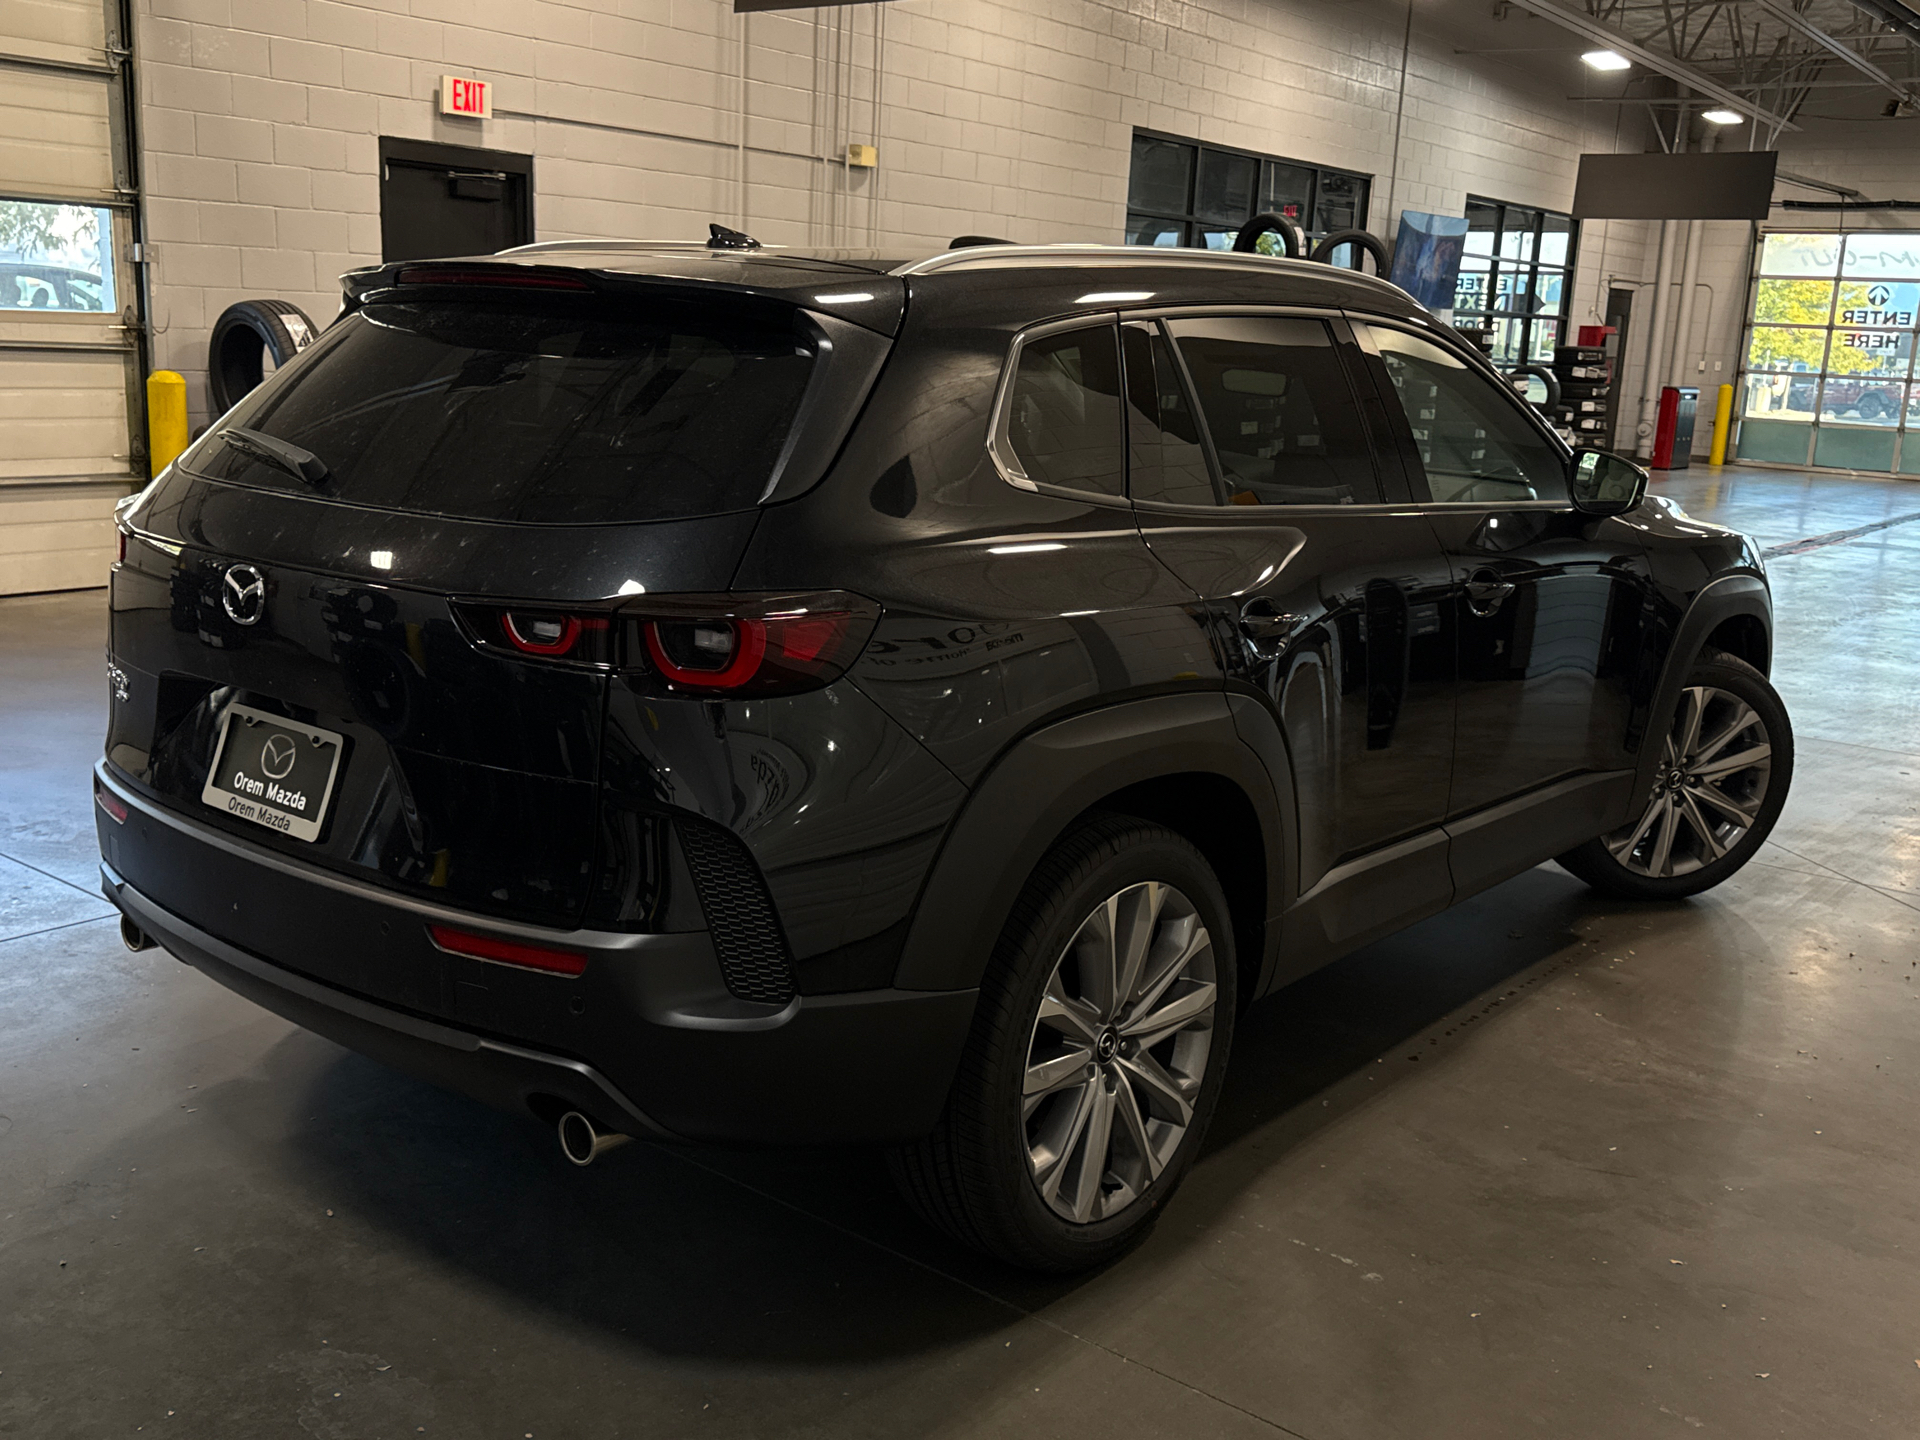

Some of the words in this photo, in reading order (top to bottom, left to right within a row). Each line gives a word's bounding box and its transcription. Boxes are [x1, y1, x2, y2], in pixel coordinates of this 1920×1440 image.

[453, 79, 486, 114] EXIT
[233, 771, 264, 796] Orem
[265, 782, 307, 811] Mazda
[228, 796, 255, 818] Orem
[256, 807, 291, 831] Mazda
